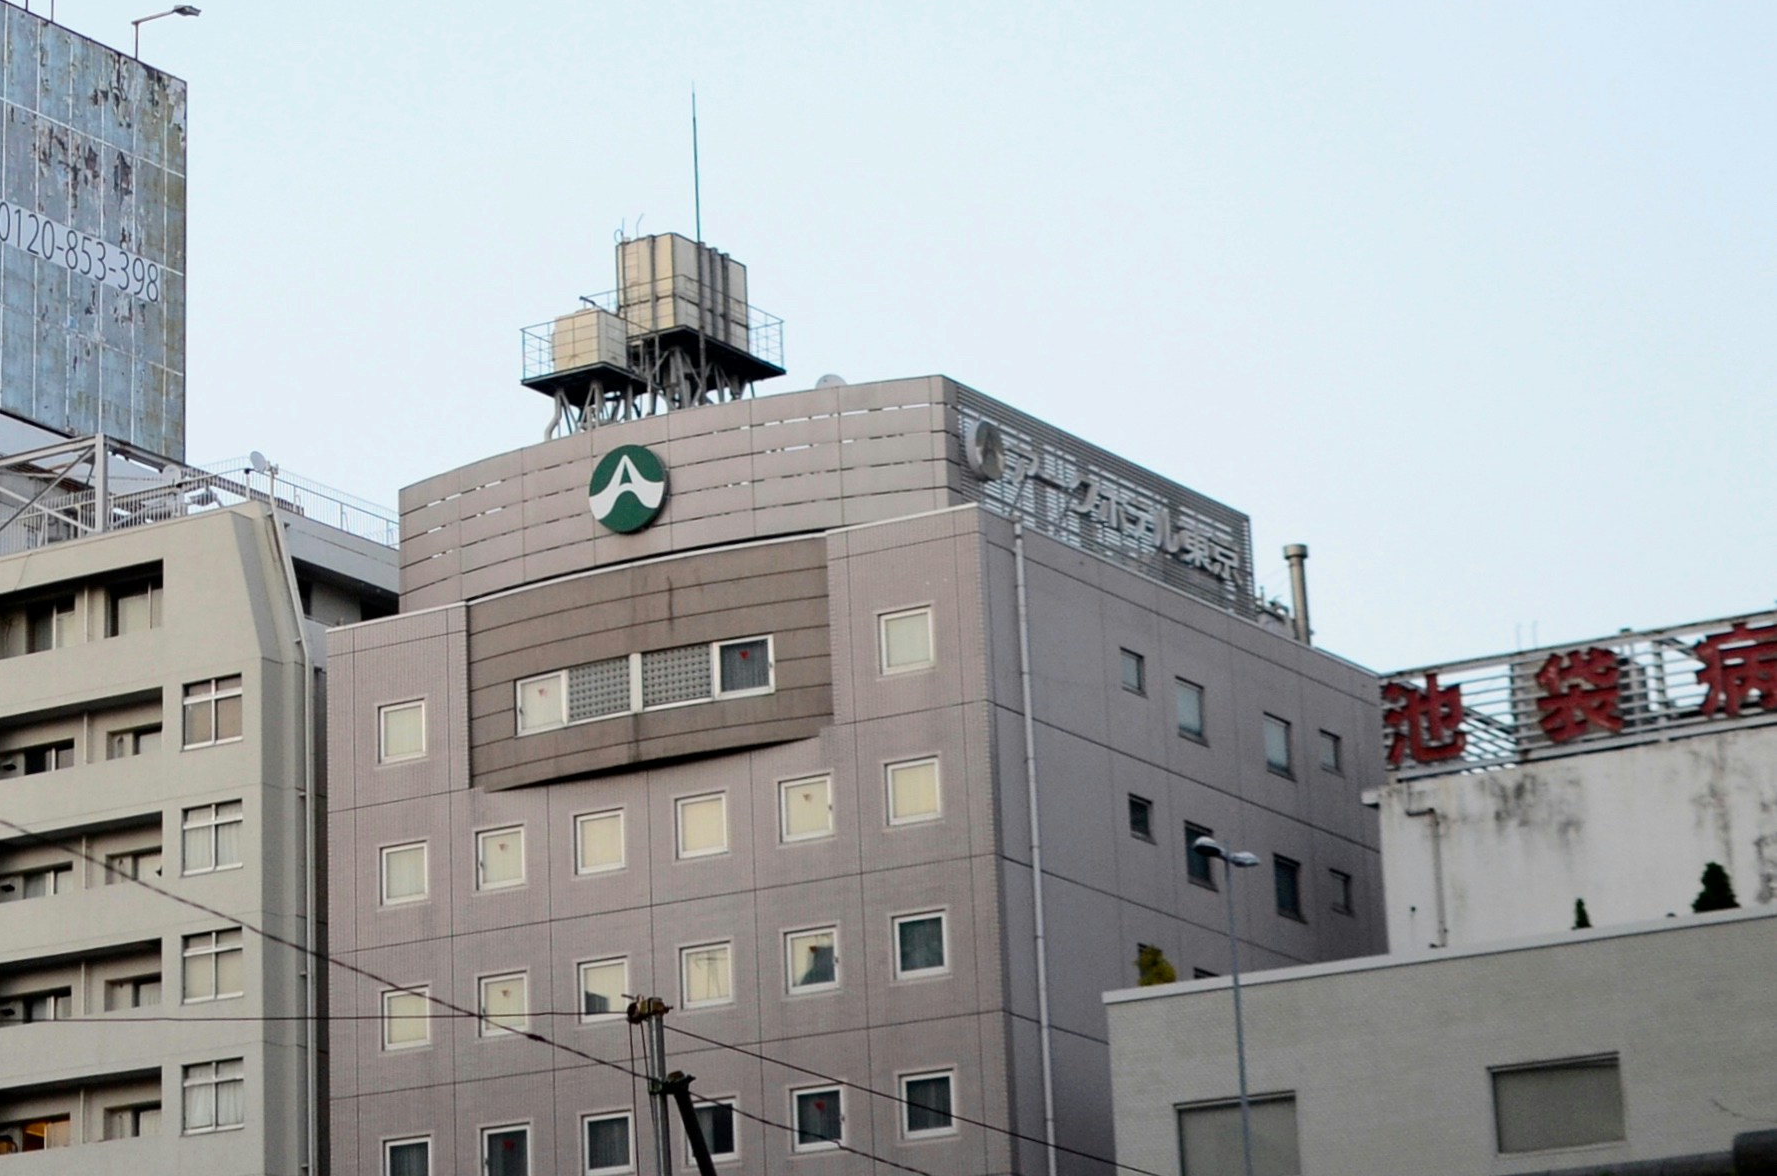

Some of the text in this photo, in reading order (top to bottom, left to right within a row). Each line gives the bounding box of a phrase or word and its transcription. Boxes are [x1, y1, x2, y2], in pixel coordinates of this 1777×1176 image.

[1003, 445, 1243, 587] アークホテル東京
